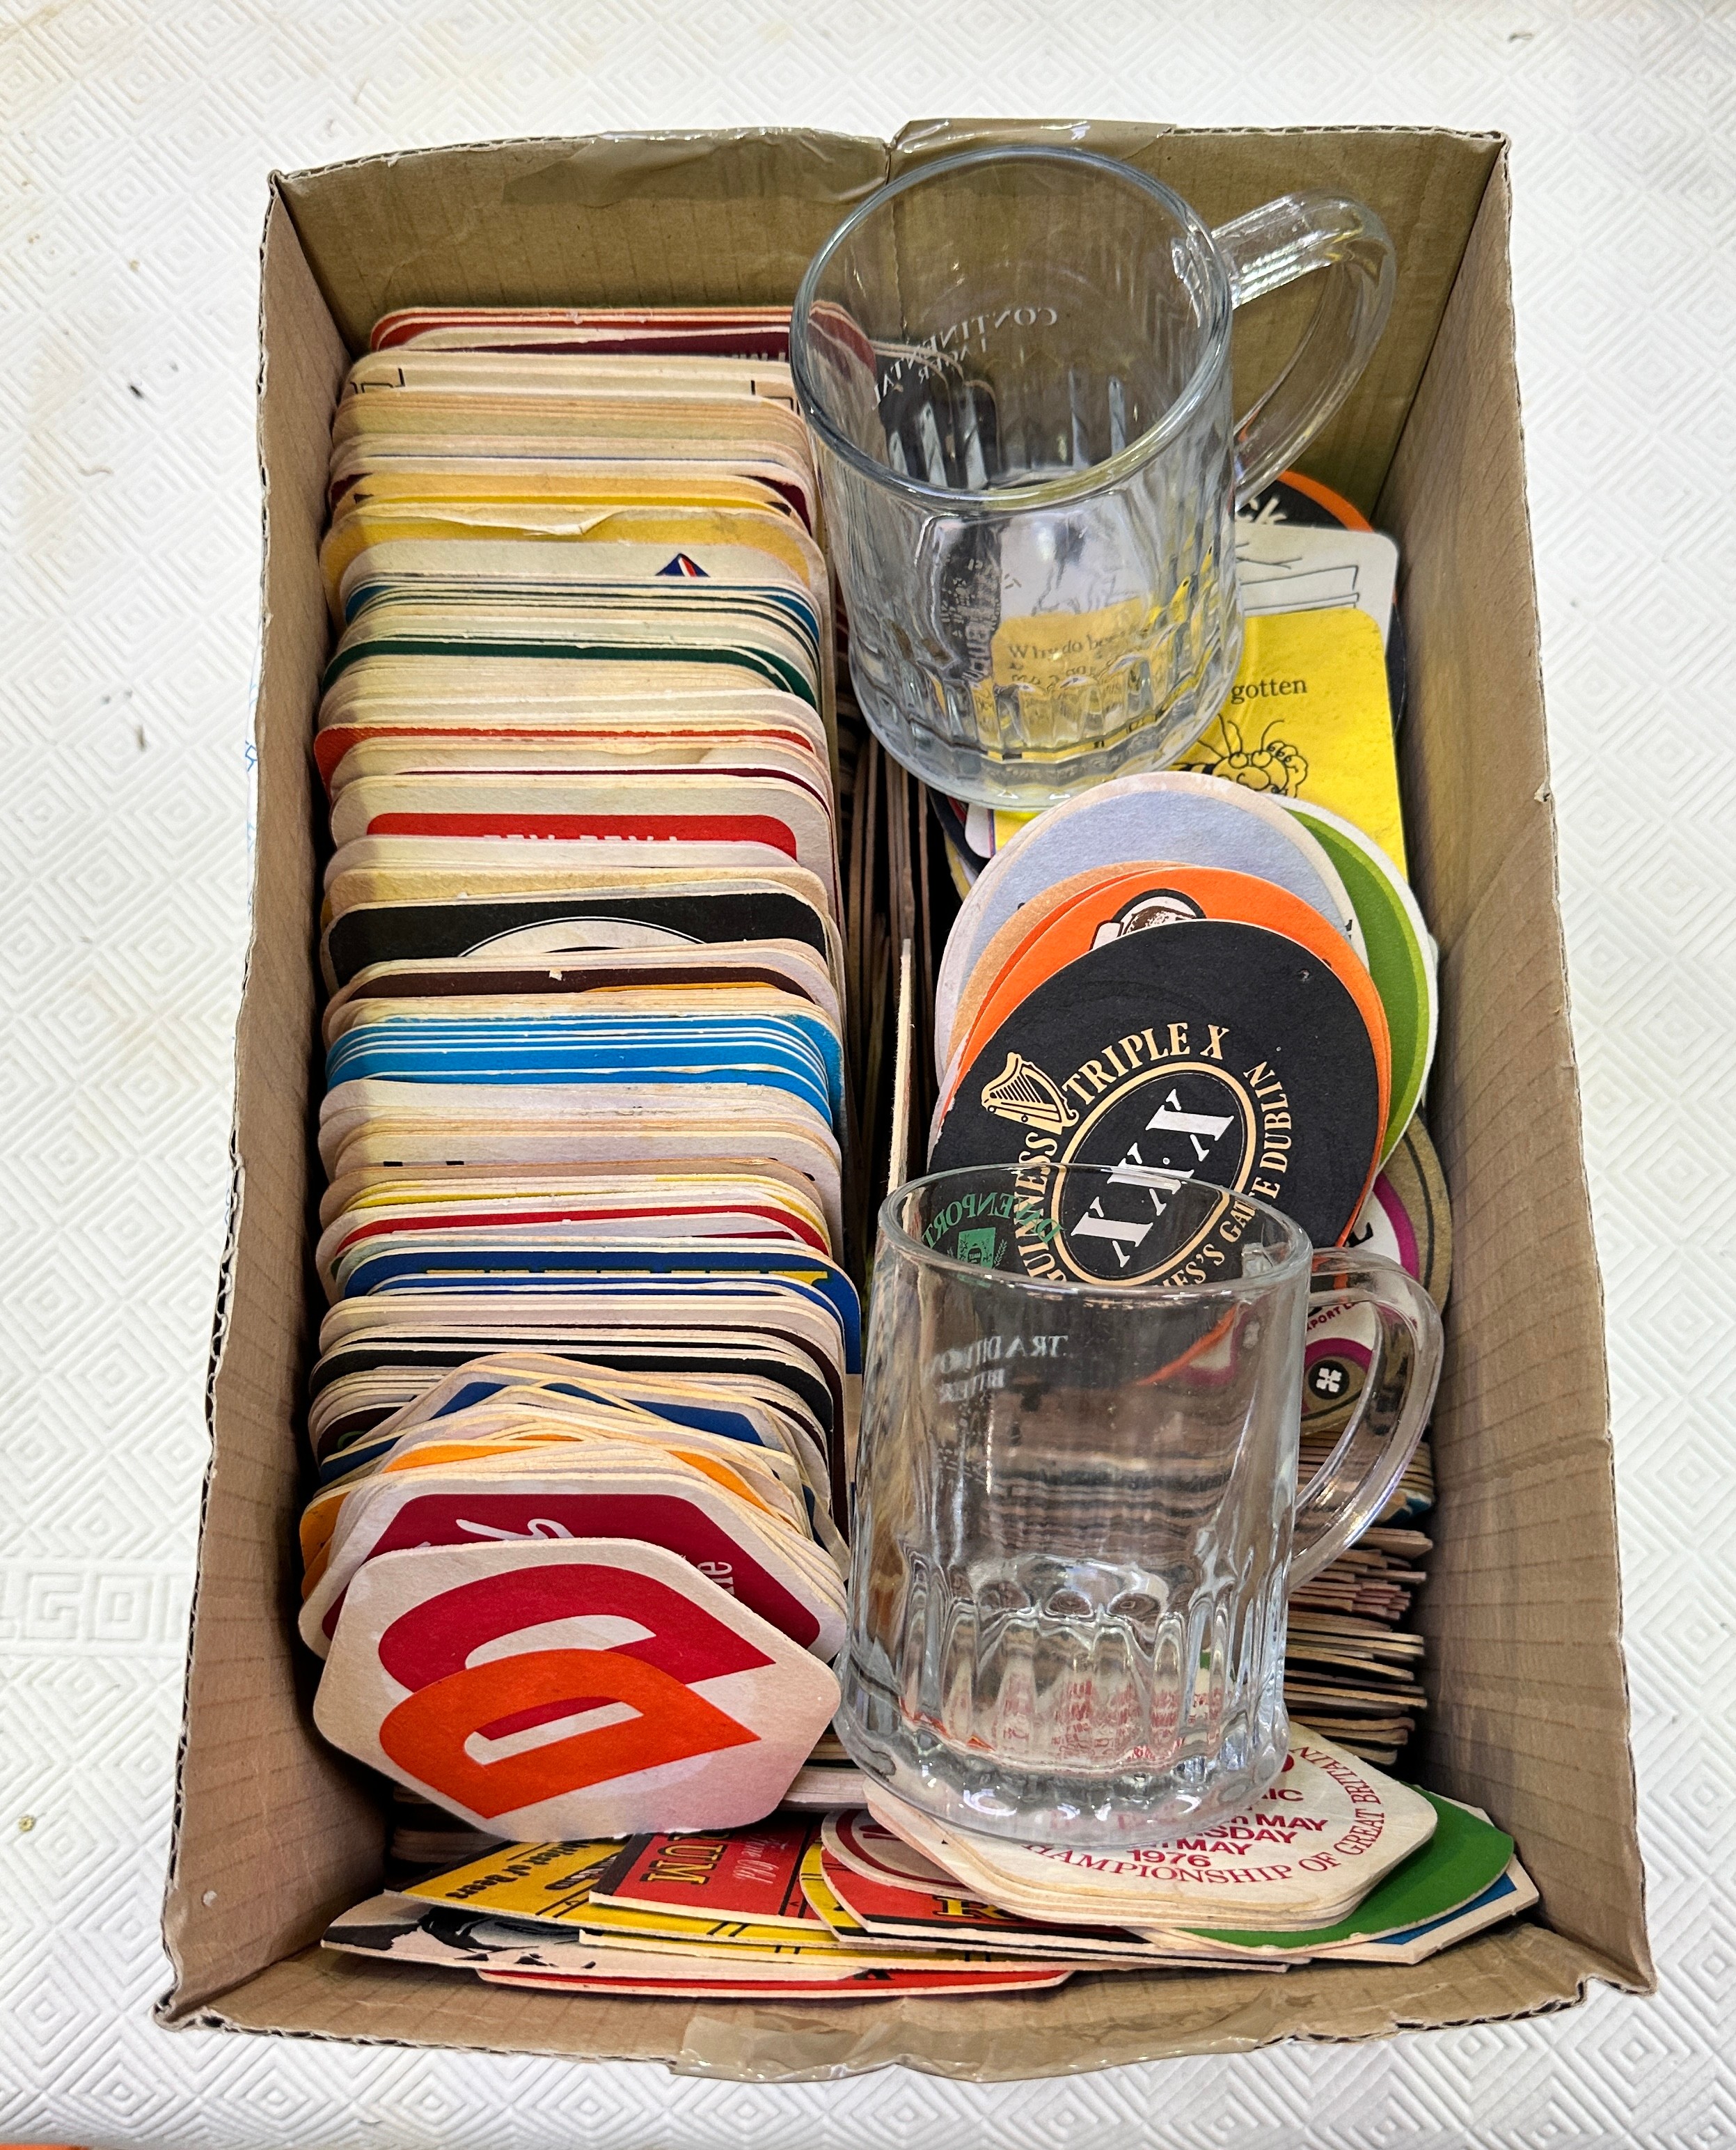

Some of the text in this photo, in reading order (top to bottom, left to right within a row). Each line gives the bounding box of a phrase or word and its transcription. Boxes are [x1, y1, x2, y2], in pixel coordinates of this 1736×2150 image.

[1062, 638, 1083, 654] do
[1061, 1022, 1230, 1106] TRIPLE X
[1243, 1061, 1293, 1174] DUBLIN
[1071, 1089, 1235, 1267] XXX
[1307, 1305, 1341, 1331] PORT
[1021, 1746, 1385, 1883] HAMPIONSHIP OF GREAT BRITAIN
[1255, 1813, 1329, 1831] MAY
[1202, 1825, 1297, 1844] SDAY
[1176, 1837, 1253, 1855] MAY
[1127, 1849, 1211, 1867] 1976
